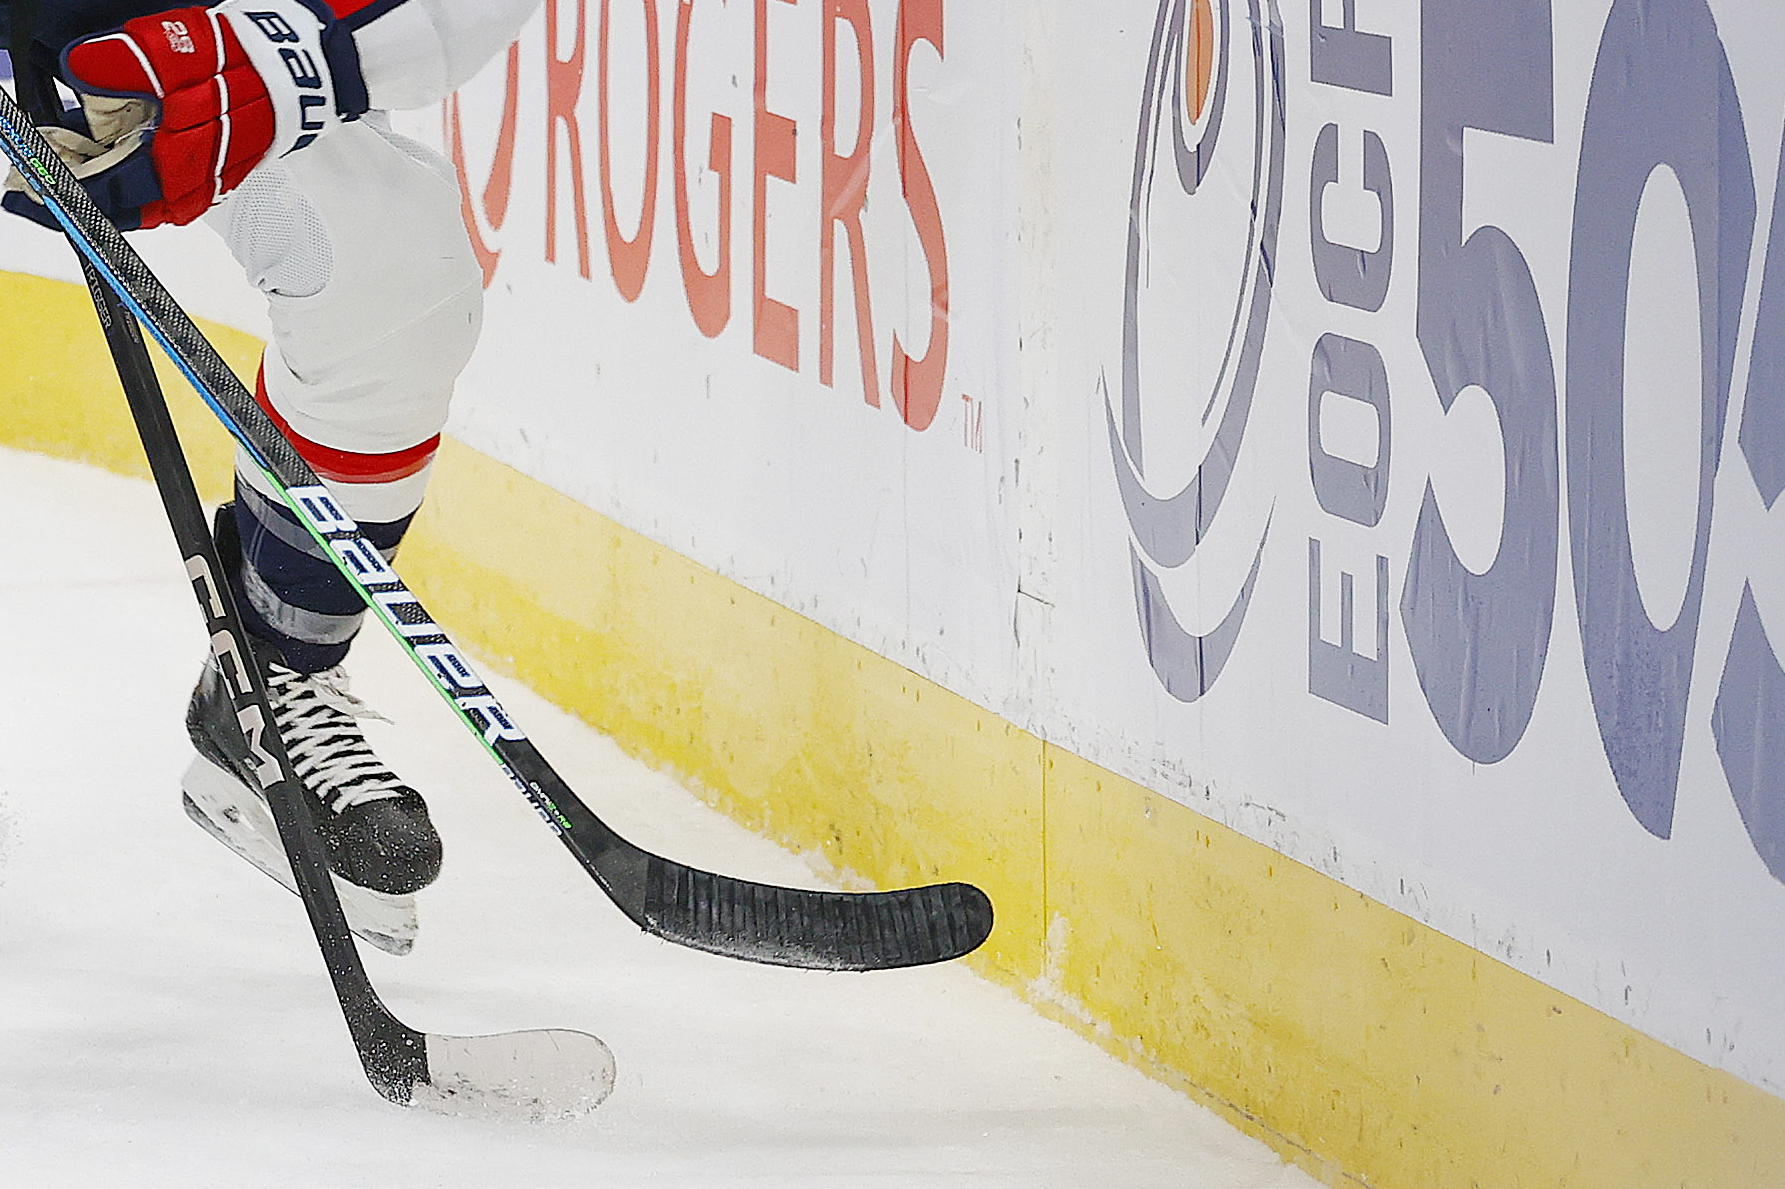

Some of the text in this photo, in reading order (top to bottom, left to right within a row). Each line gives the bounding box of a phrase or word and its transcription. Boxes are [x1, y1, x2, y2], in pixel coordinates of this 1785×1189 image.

[85, 262, 113, 331] TRIGGER
[184, 553, 286, 789] CCM
[284, 484, 528, 748] BAUER
